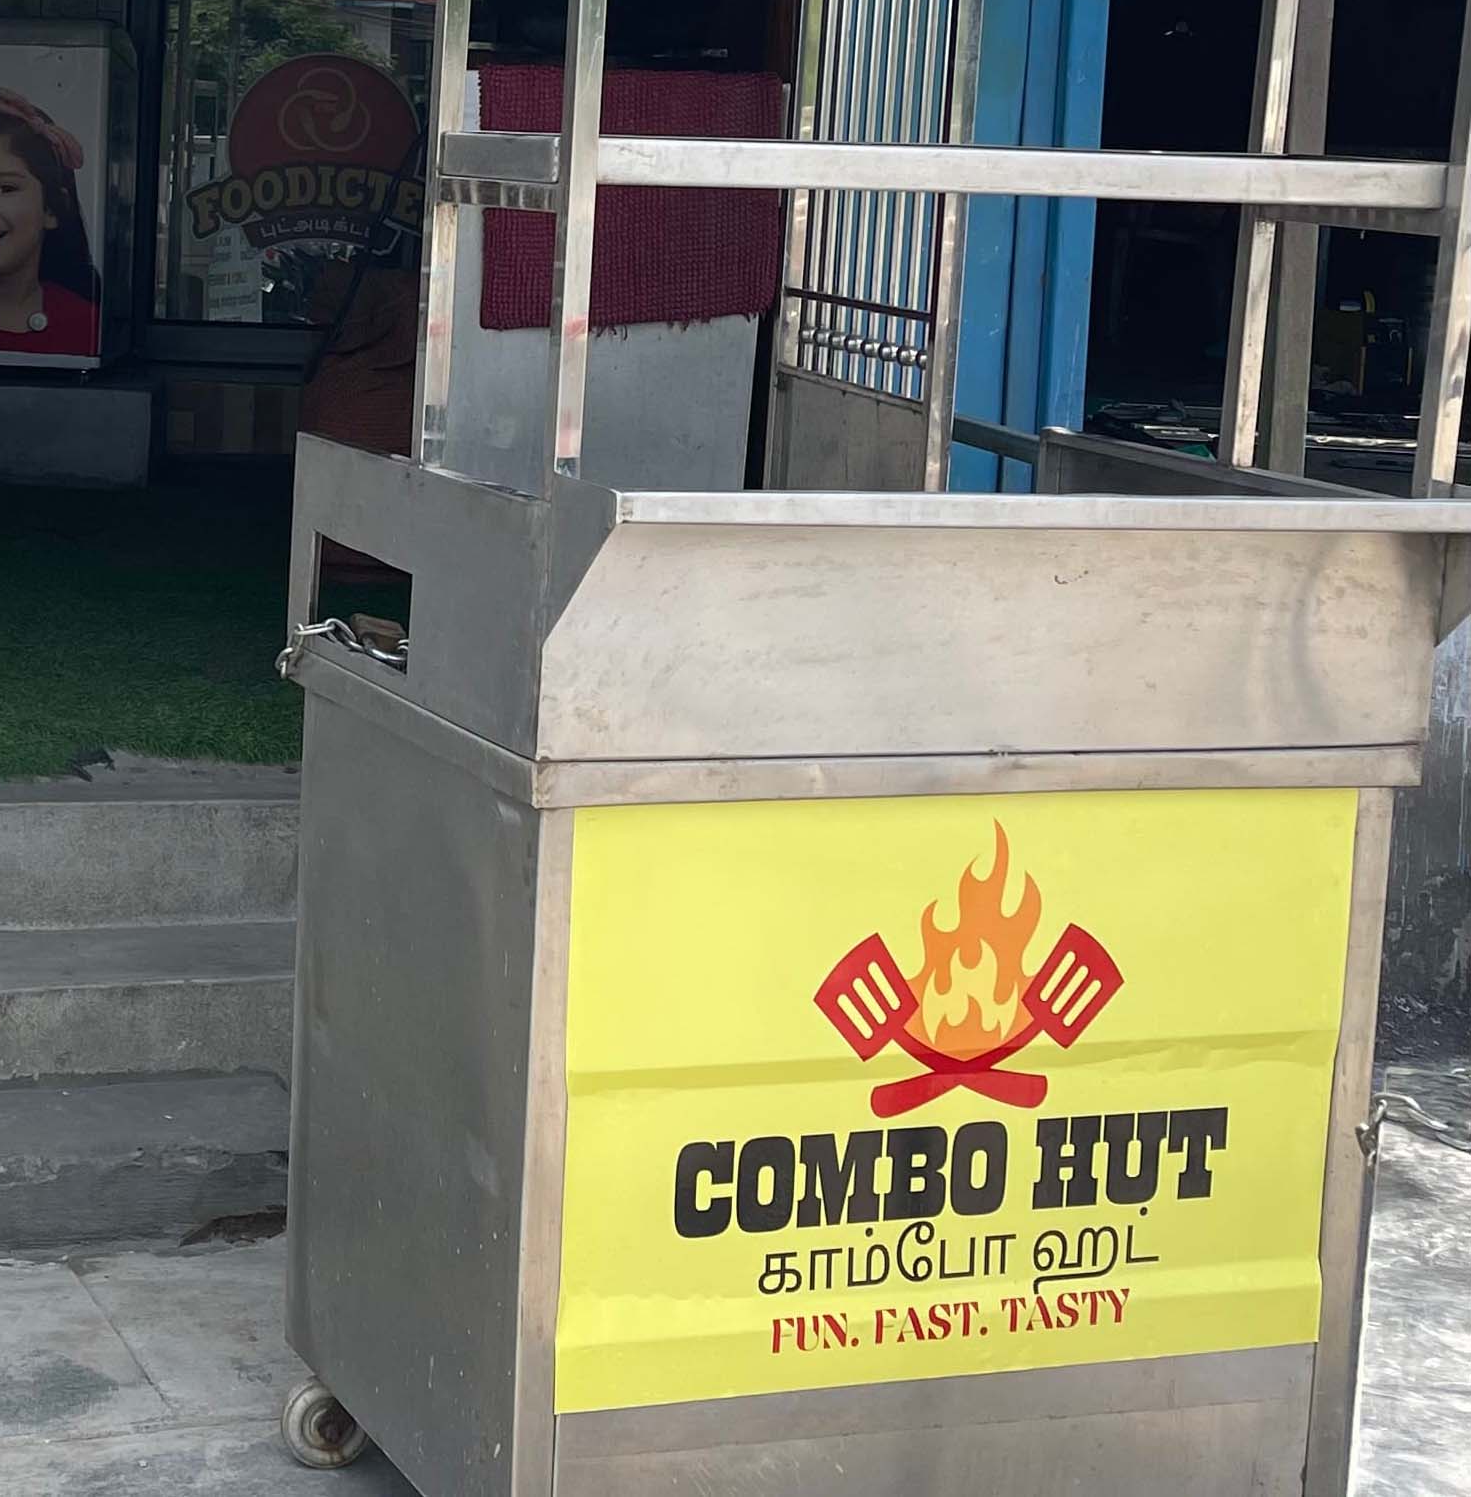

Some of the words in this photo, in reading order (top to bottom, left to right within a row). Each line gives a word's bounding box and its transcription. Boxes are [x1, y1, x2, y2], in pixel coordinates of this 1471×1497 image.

[190, 165, 425, 234] FOODICTE
[673, 1120, 1009, 1240] COMBO
[1031, 1106, 1229, 1211] HUT
[757, 1220, 1017, 1295] காம்போ
[1032, 1205, 1160, 1295] ஹட்
[771, 1313, 860, 1354] FUN.
[874, 1301, 989, 1345] FAST.
[1001, 1288, 1130, 1339] TASTY
